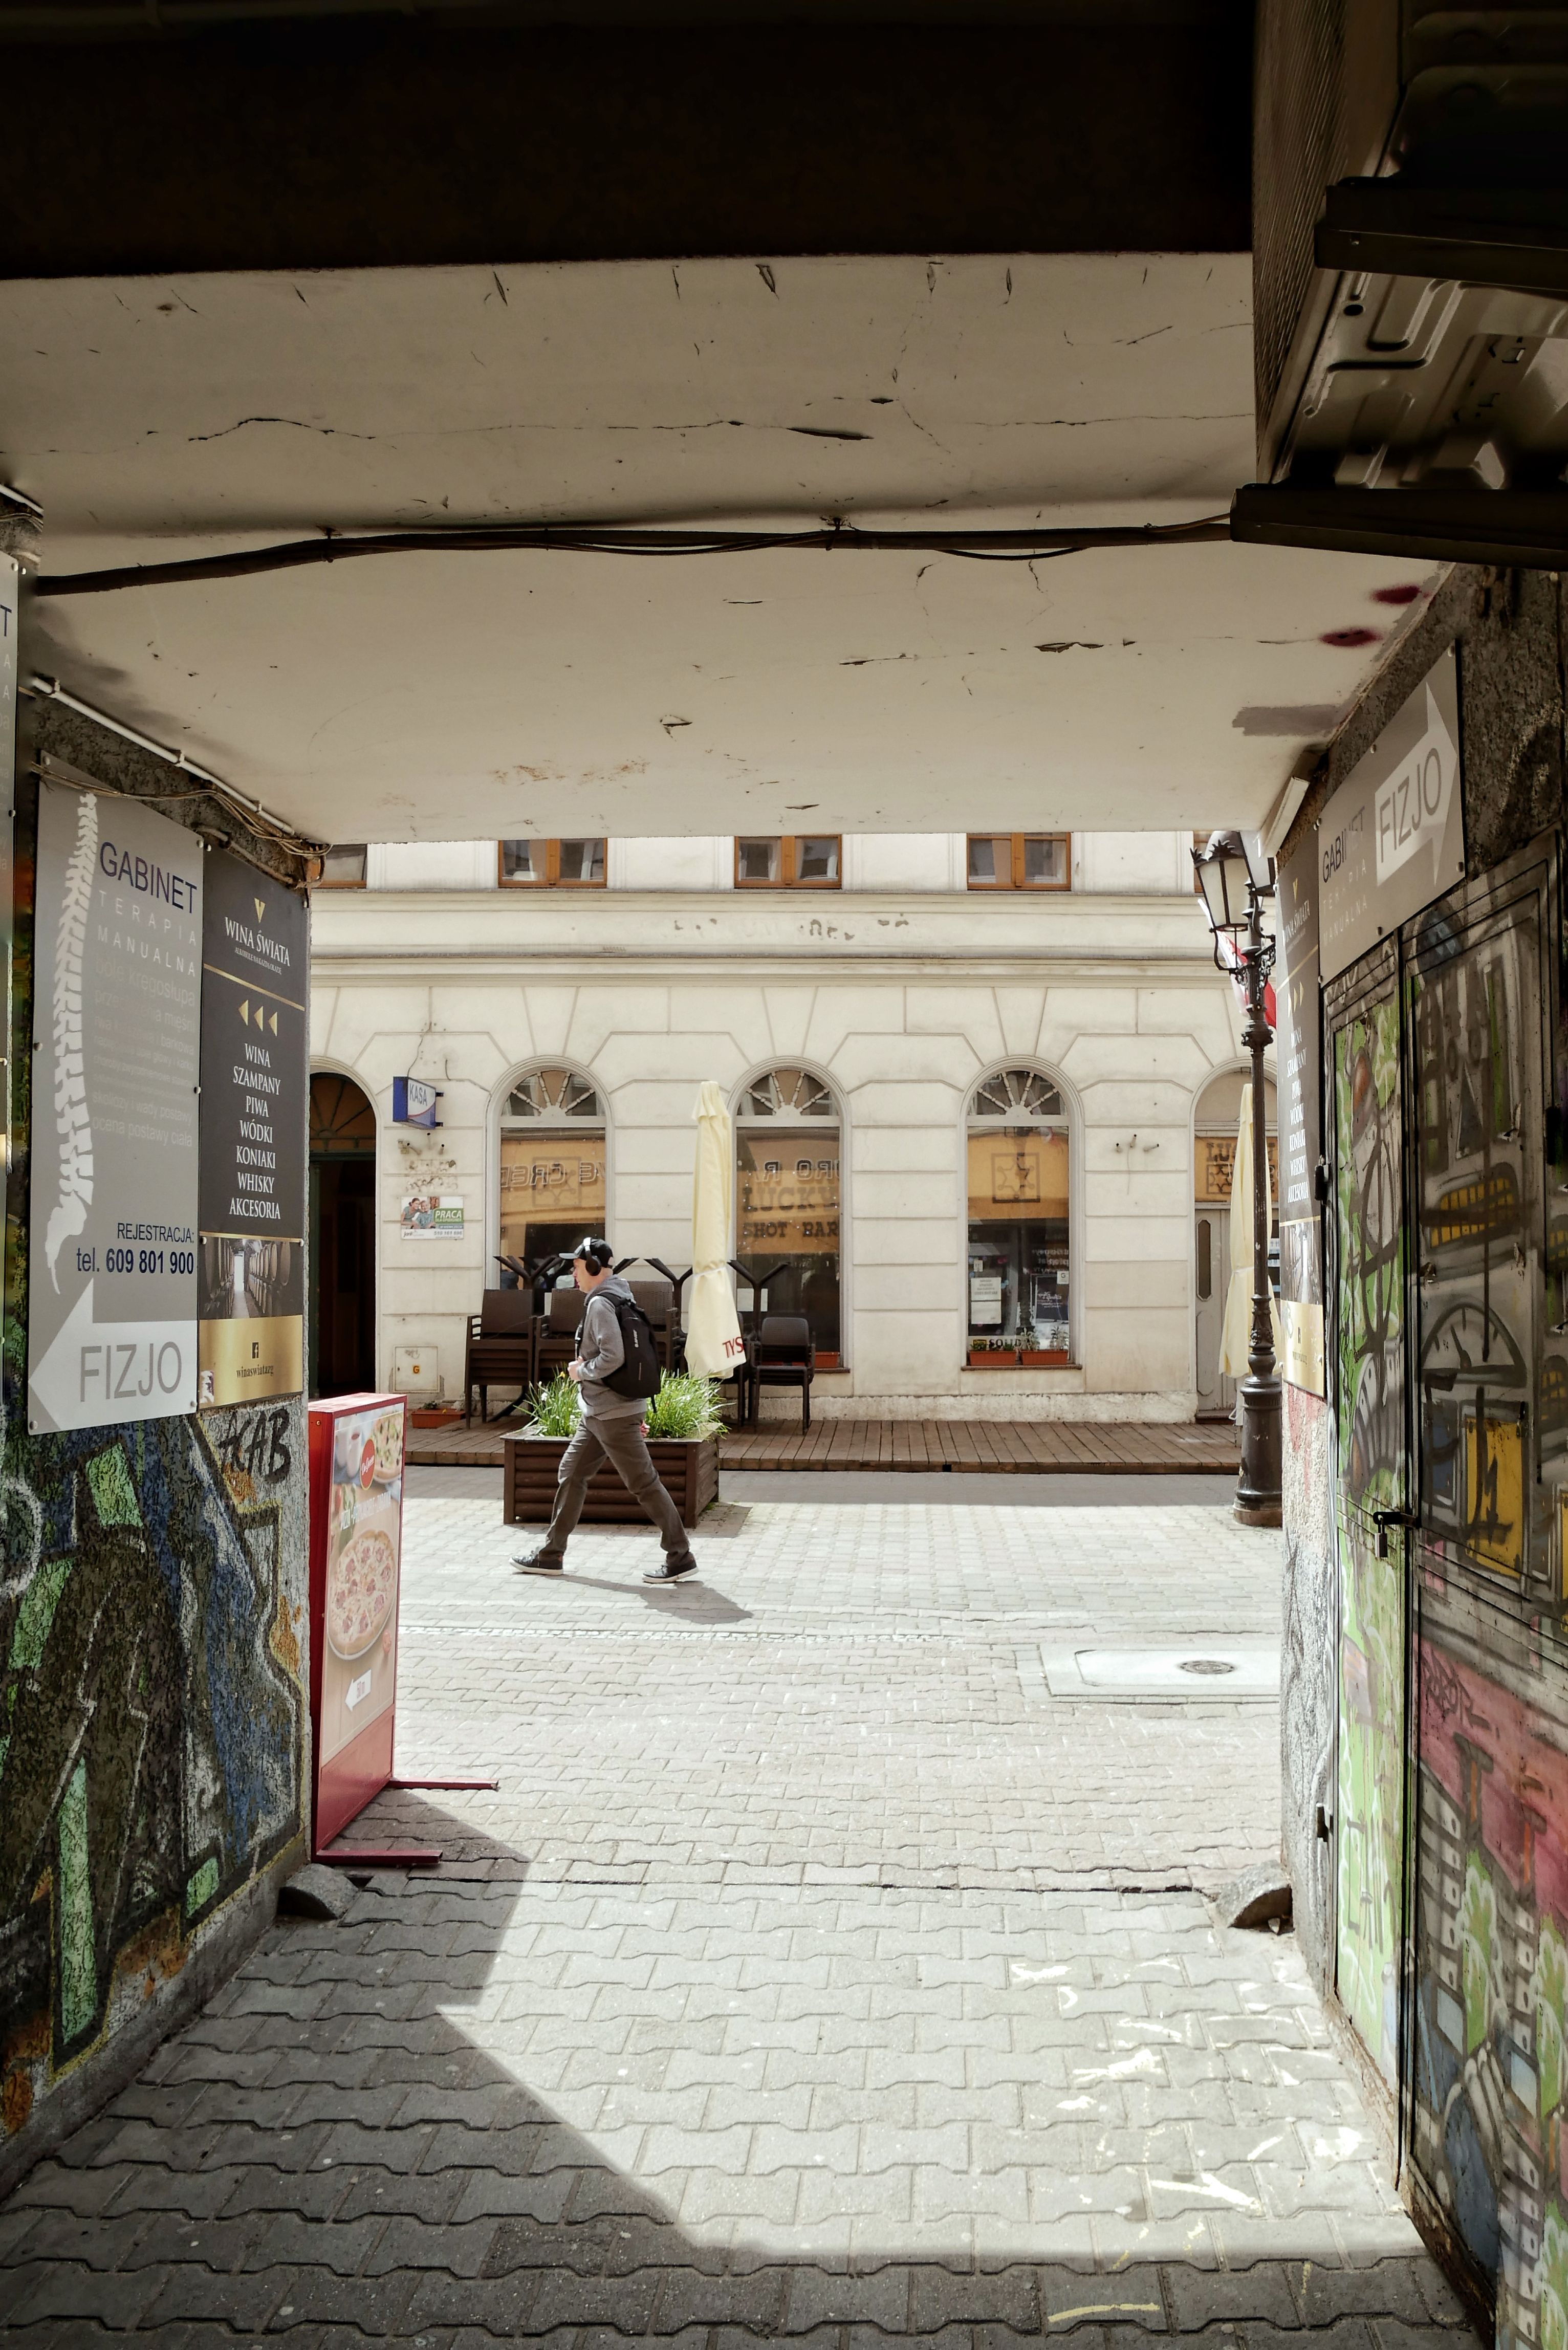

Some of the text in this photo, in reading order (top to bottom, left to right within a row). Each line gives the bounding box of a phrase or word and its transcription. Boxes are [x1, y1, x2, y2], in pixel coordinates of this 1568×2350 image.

[1380, 748, 1442, 863] FIZJO
[99, 841, 197, 913] GABINET
[98, 890, 196, 946] TERAPIA
[97, 925, 195, 977] MANUALNA
[225, 917, 291, 967] WINA ŚWIATA
[161, 1033, 194, 1055] barkowa
[245, 1043, 271, 1068] WINA
[233, 1065, 281, 1096] SZAMPANY
[246, 1095, 270, 1118] PIWA
[409, 1083, 427, 1106] KASA
[92, 1115, 192, 1147] ocena postawy ciała
[239, 1119, 273, 1144] WÓDKI
[236, 1145, 276, 1170] KONIAKI
[237, 1171, 275, 1194] WHISKY
[229, 1198, 281, 1220] AKCESORIA
[743, 1186, 839, 1212] LUCKY
[435, 1210, 462, 1218] PRACA
[117, 1223, 194, 1244] REJESTRACJA:
[743, 1221, 839, 1237] SHOT BAR
[77, 1249, 194, 1275] tel. 609 801 900
[80, 1341, 182, 1402] FIZJO
[236, 1363, 274, 1379] winaswiatazg
[413, 1365, 420, 1374] G
